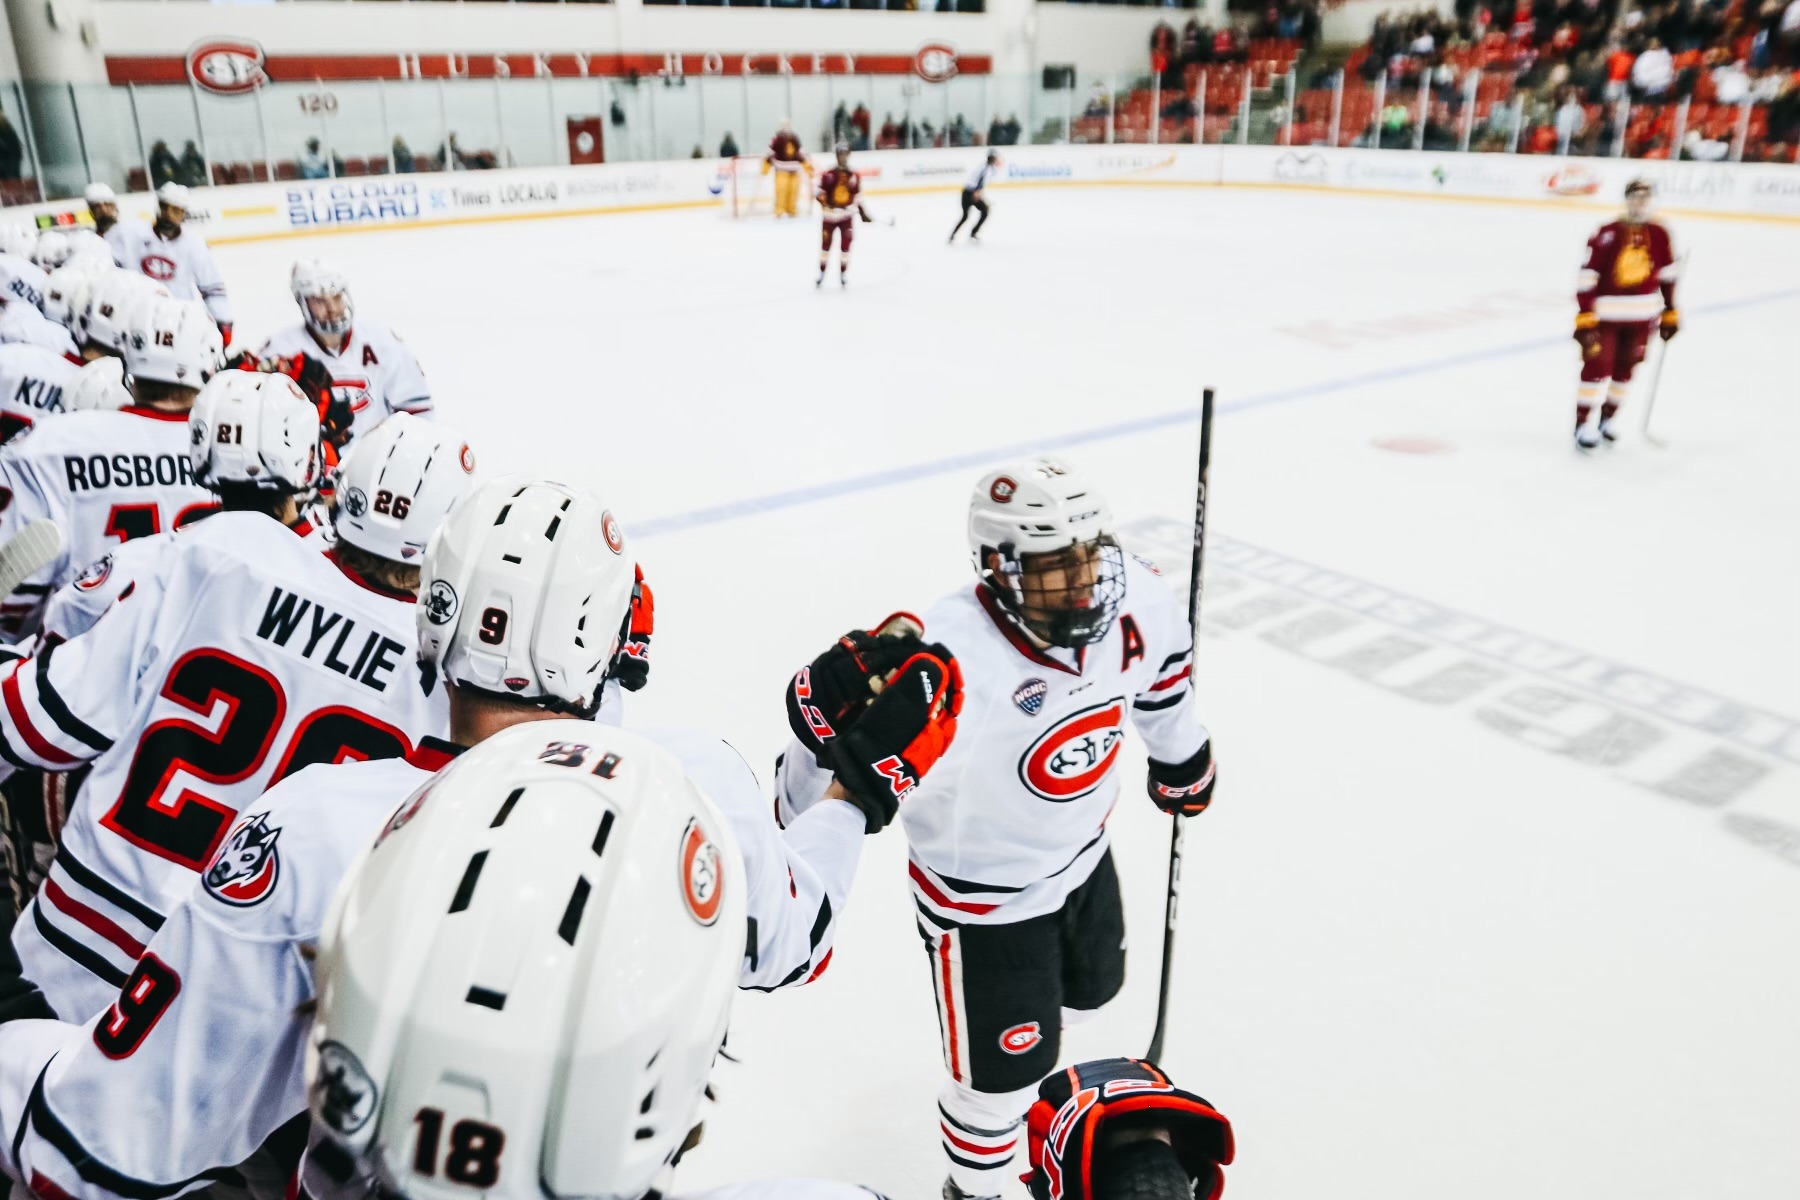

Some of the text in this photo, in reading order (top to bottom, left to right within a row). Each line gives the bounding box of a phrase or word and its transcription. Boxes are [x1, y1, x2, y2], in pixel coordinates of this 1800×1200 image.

[399, 51, 855, 78] HUSKY HOCKEY
[299, 93, 338, 113] 120
[288, 197, 419, 226] SUBARU
[362, 343, 379, 367] A
[374, 489, 411, 521] 26
[257, 586, 405, 693] WYLIE
[478, 606, 509, 646] 9
[1119, 613, 1146, 674] A
[1013, 680, 1048, 704] NCHC
[93, 951, 182, 1061] 9
[413, 1106, 506, 1189] 18
